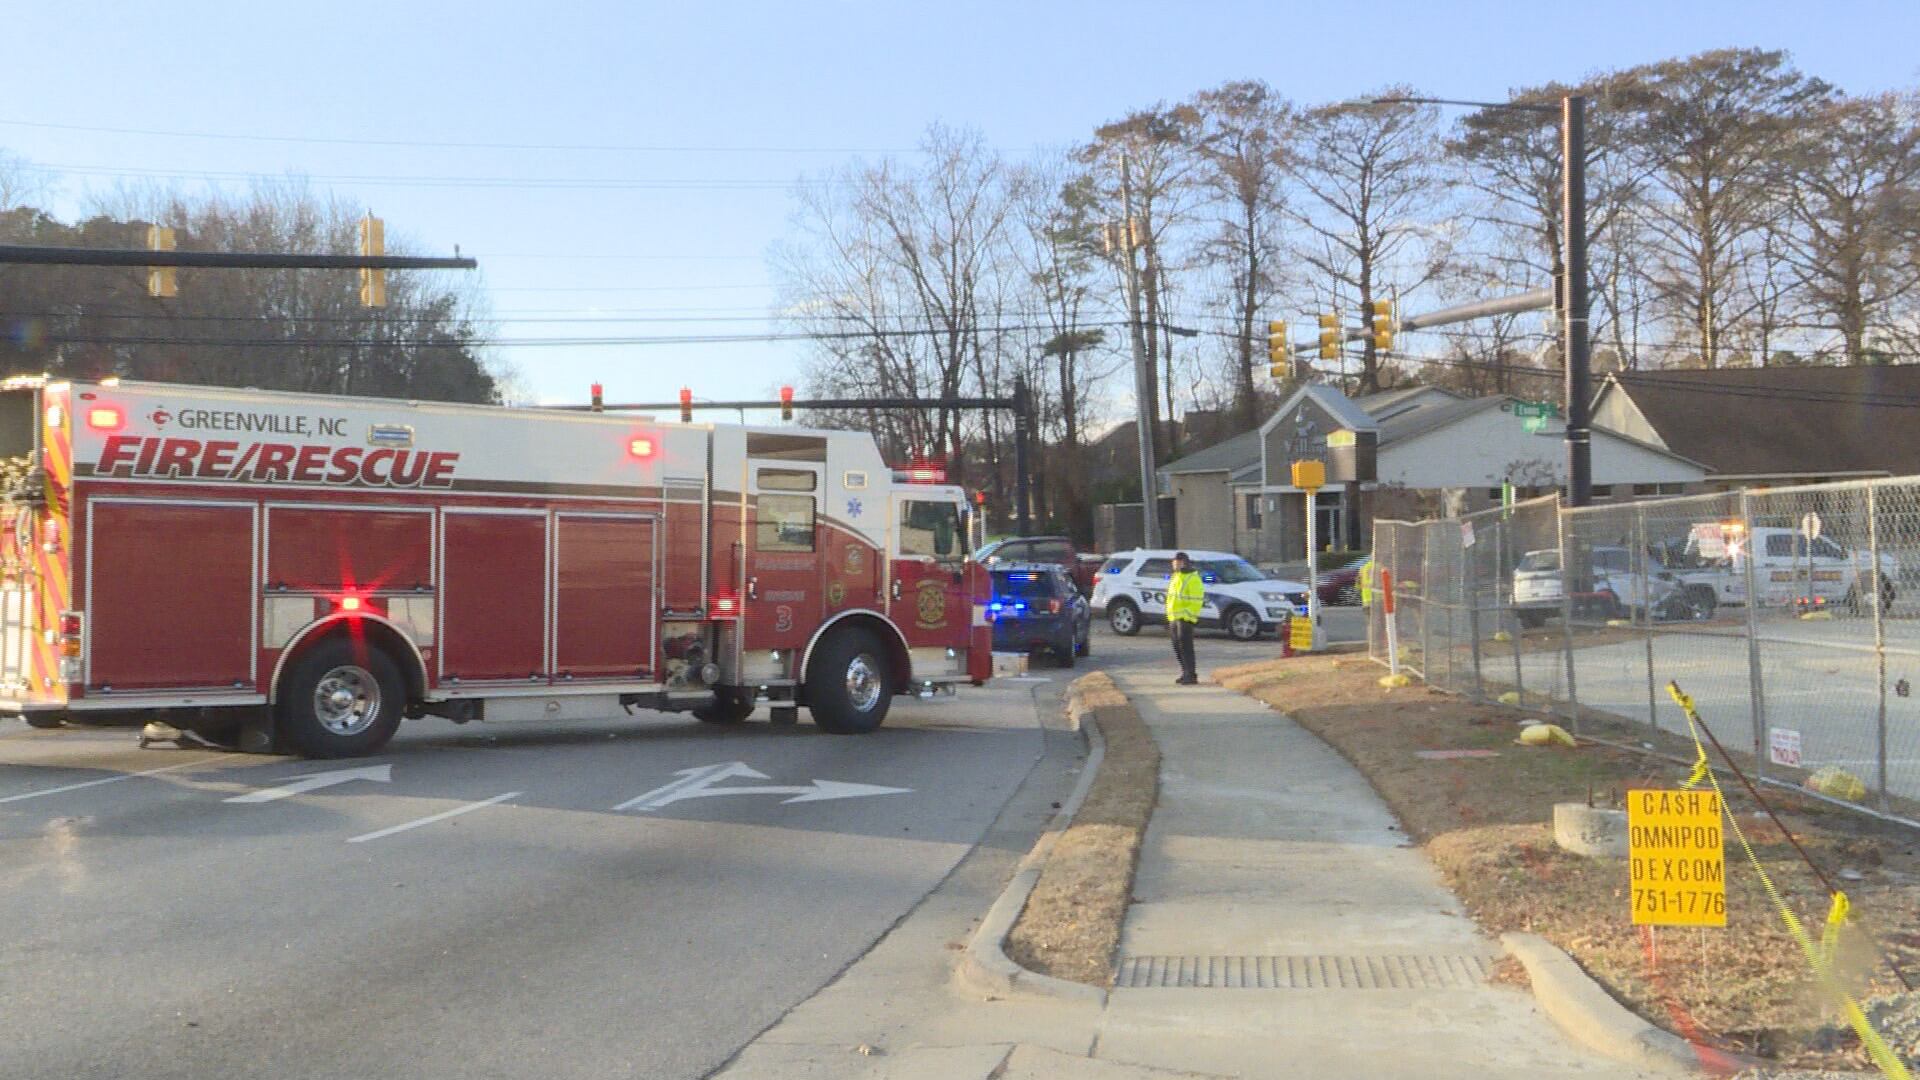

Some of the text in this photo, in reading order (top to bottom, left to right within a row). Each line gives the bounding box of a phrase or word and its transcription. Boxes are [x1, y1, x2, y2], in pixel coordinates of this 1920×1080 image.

[177, 408, 312, 438] GREENVILLE,
[319, 419, 348, 438] NC
[97, 435, 460, 488] FIRE/RESCUE
[775, 605, 793, 633] 3
[1708, 793, 1719, 816] 4
[1631, 826, 1719, 849] OMNIPOD
[1633, 858, 1722, 882] DEXCOM
[1634, 889, 1725, 914] 751-1776
